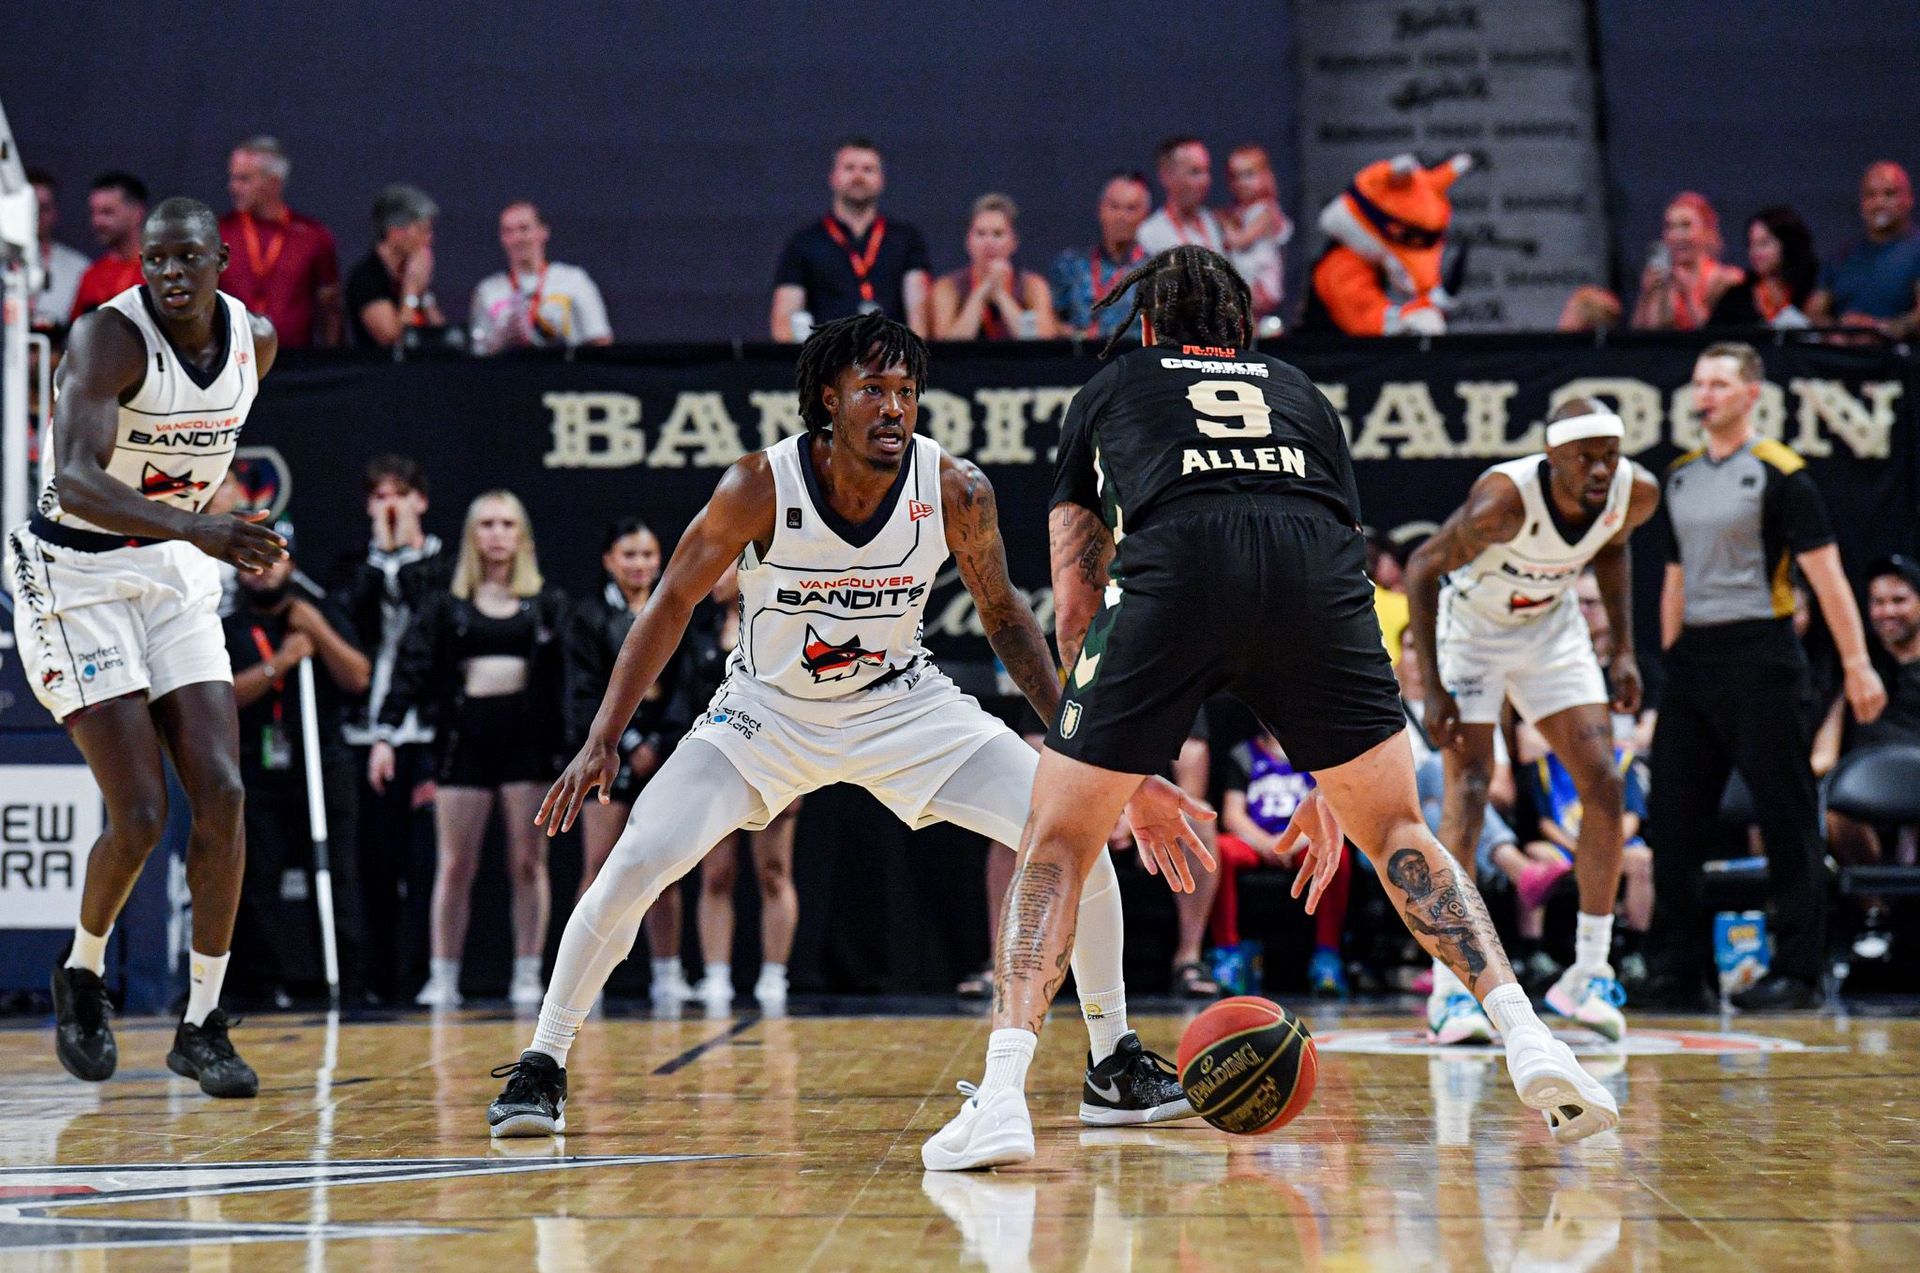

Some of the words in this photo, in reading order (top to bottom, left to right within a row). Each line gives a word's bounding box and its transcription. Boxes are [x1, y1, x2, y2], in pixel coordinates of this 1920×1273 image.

[1160, 358, 1267, 373] COOKE
[1185, 380, 1272, 439] 9
[1181, 446, 1306, 479] ALLEN
[777, 582, 927, 609] BANDITS
[800, 575, 914, 590] VANCOUVER
[1186, 1042, 1262, 1110] SPALDING
